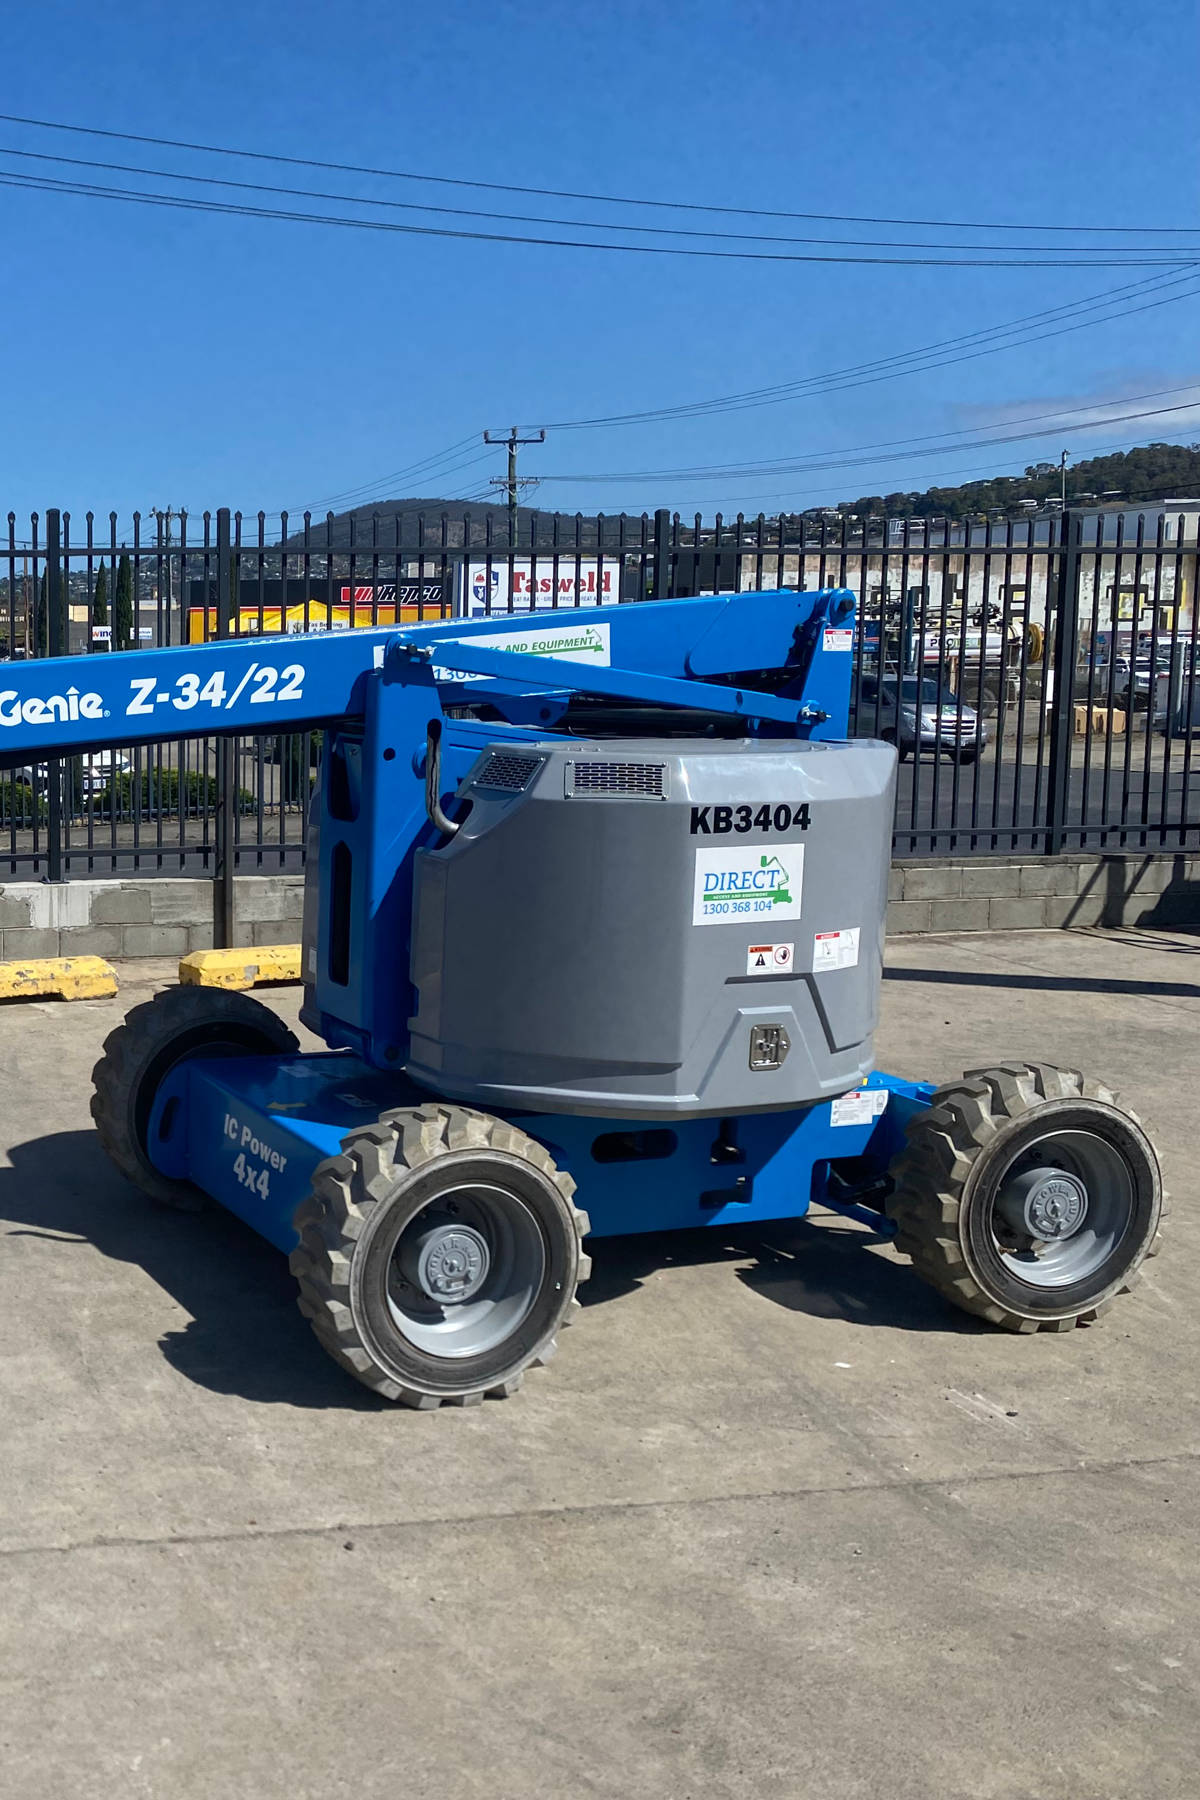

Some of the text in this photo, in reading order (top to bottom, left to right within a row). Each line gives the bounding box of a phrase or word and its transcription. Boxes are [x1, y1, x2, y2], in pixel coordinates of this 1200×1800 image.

[511, 571, 611, 593] Tasweld
[505, 636, 595, 652] AND EQUIPMENT
[125, 662, 306, 716] Z-34/22
[689, 803, 812, 835] KB3404
[703, 869, 780, 892] DIRECT
[703, 900, 772, 915] 1300 368 104
[224, 1113, 287, 1173] IC Power
[233, 1152, 270, 1200] 4x4
